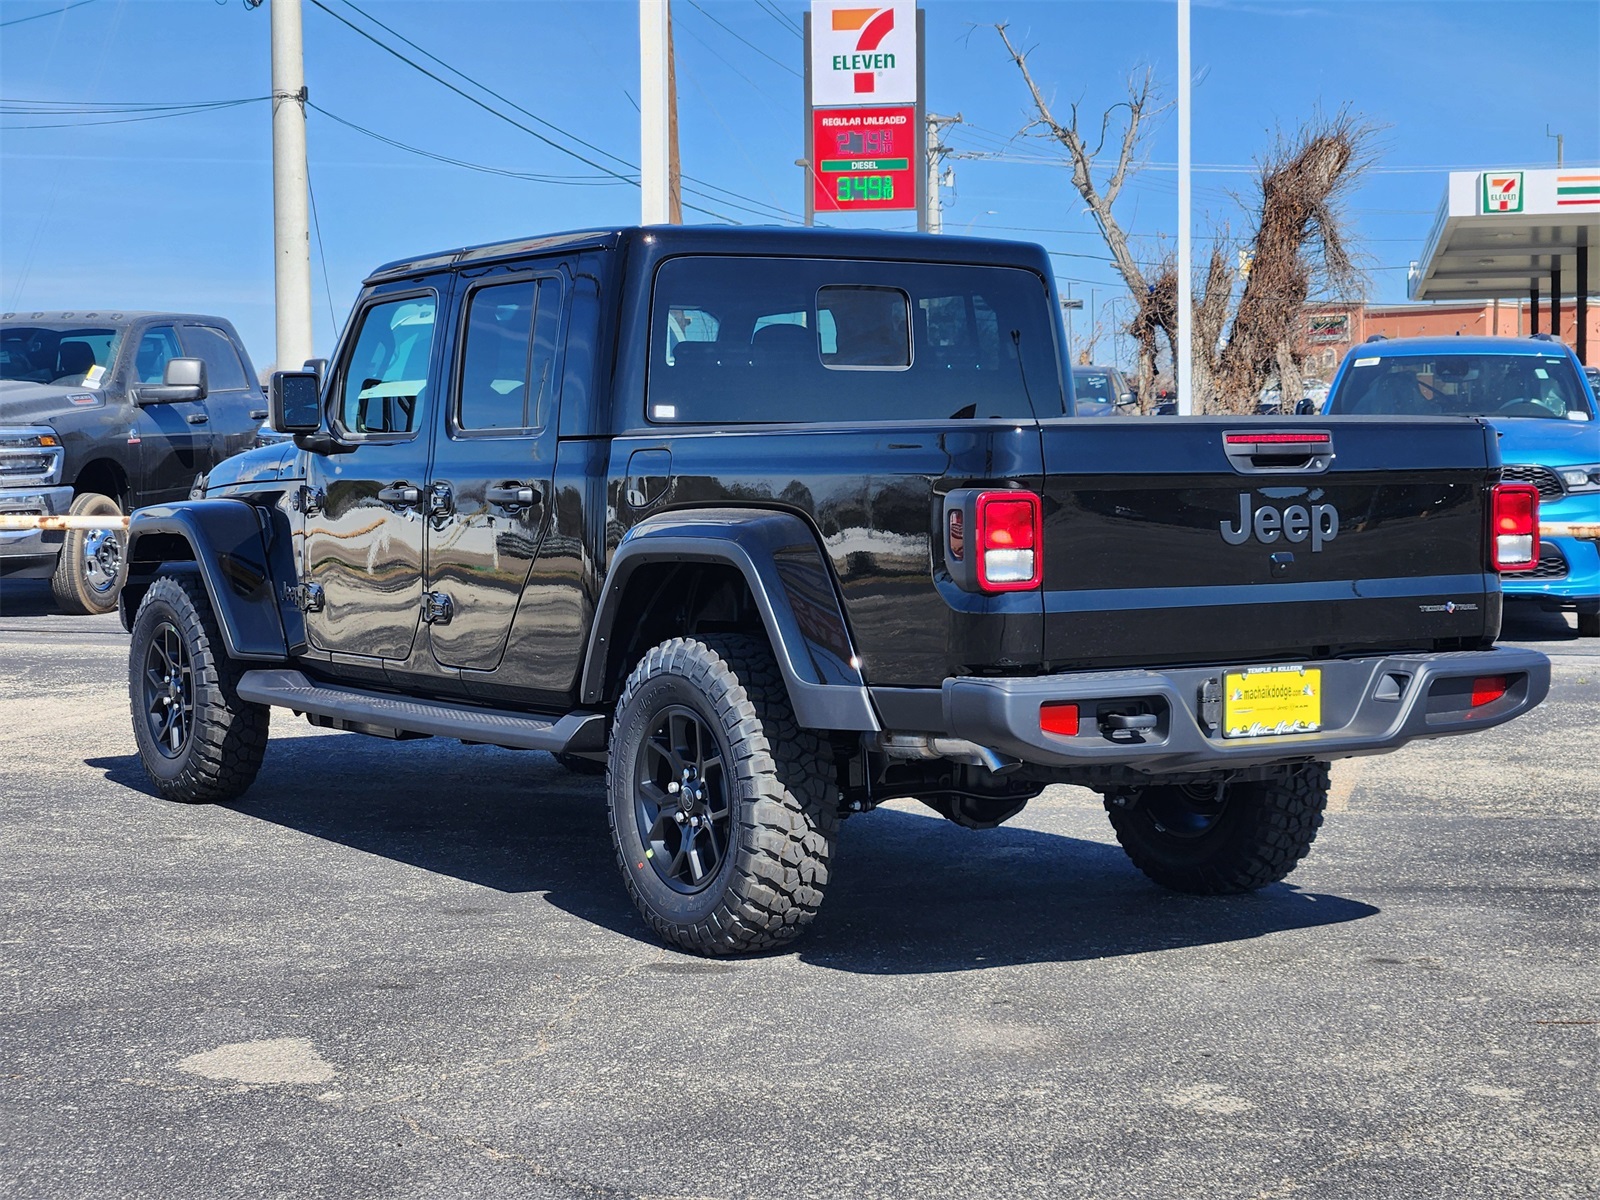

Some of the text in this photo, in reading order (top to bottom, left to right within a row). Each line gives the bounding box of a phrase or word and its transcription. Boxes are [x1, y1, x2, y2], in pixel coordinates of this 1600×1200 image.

[832, 8, 894, 51] 7
[822, 116, 907, 126] REGULAR UNLEADED
[851, 161, 878, 170] DIESEL
[837, 176, 881, 201] 3.49
[1219, 493, 1340, 553] Jeep
[1244, 684, 1302, 700] machaikdodge.com
[1248, 719, 1302, 737] Mac Haik
